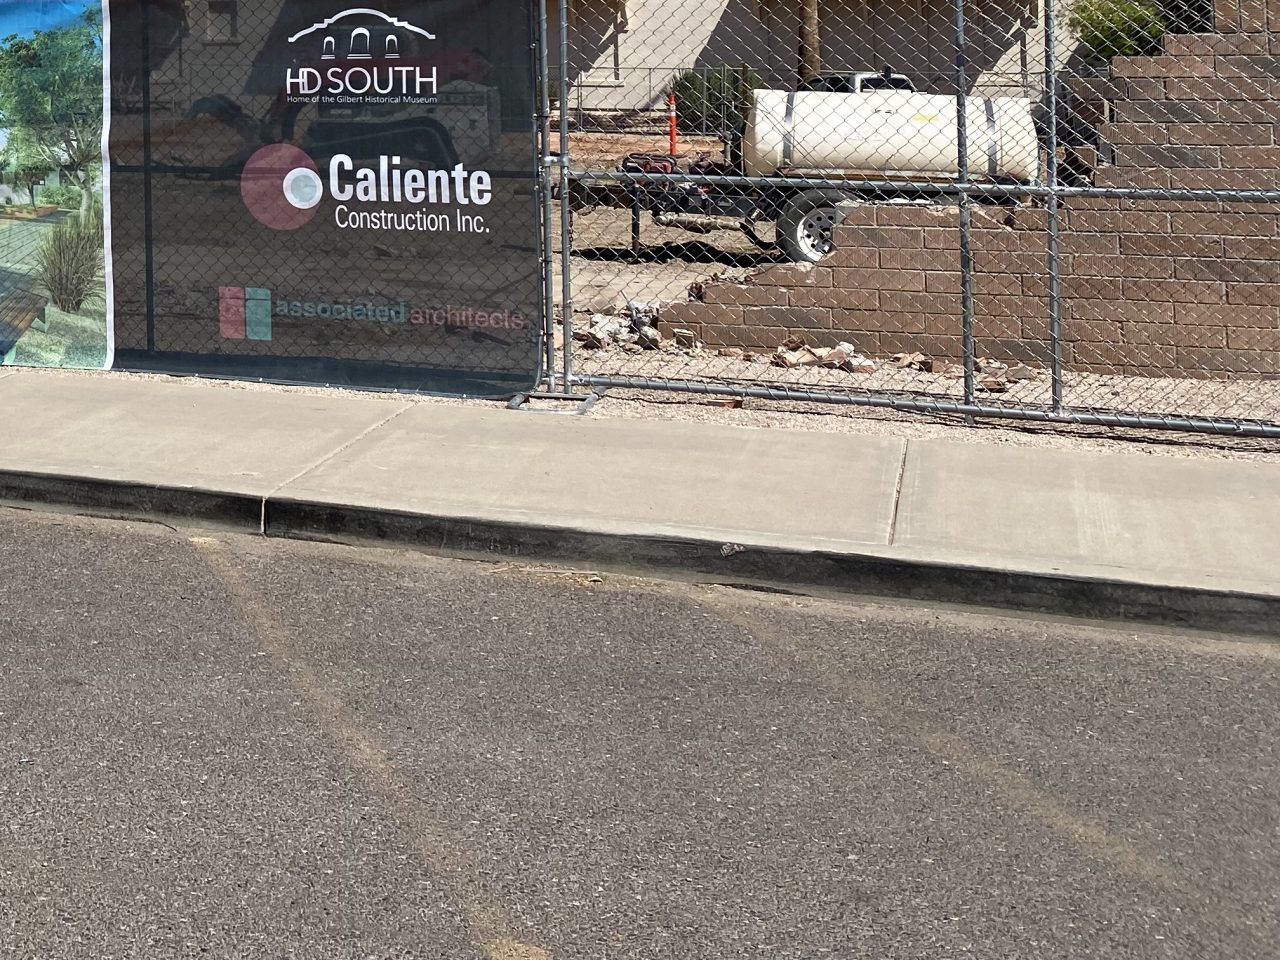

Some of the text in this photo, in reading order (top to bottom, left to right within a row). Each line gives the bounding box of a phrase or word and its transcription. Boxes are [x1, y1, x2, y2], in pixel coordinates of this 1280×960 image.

[286, 66, 437, 94] HD SOUTH
[336, 95, 363, 103] Gilbert
[365, 95, 401, 103] Historical
[329, 153, 492, 205] Caliente
[335, 204, 490, 233] Construction Inc.
[275, 299, 525, 330] associated architects
